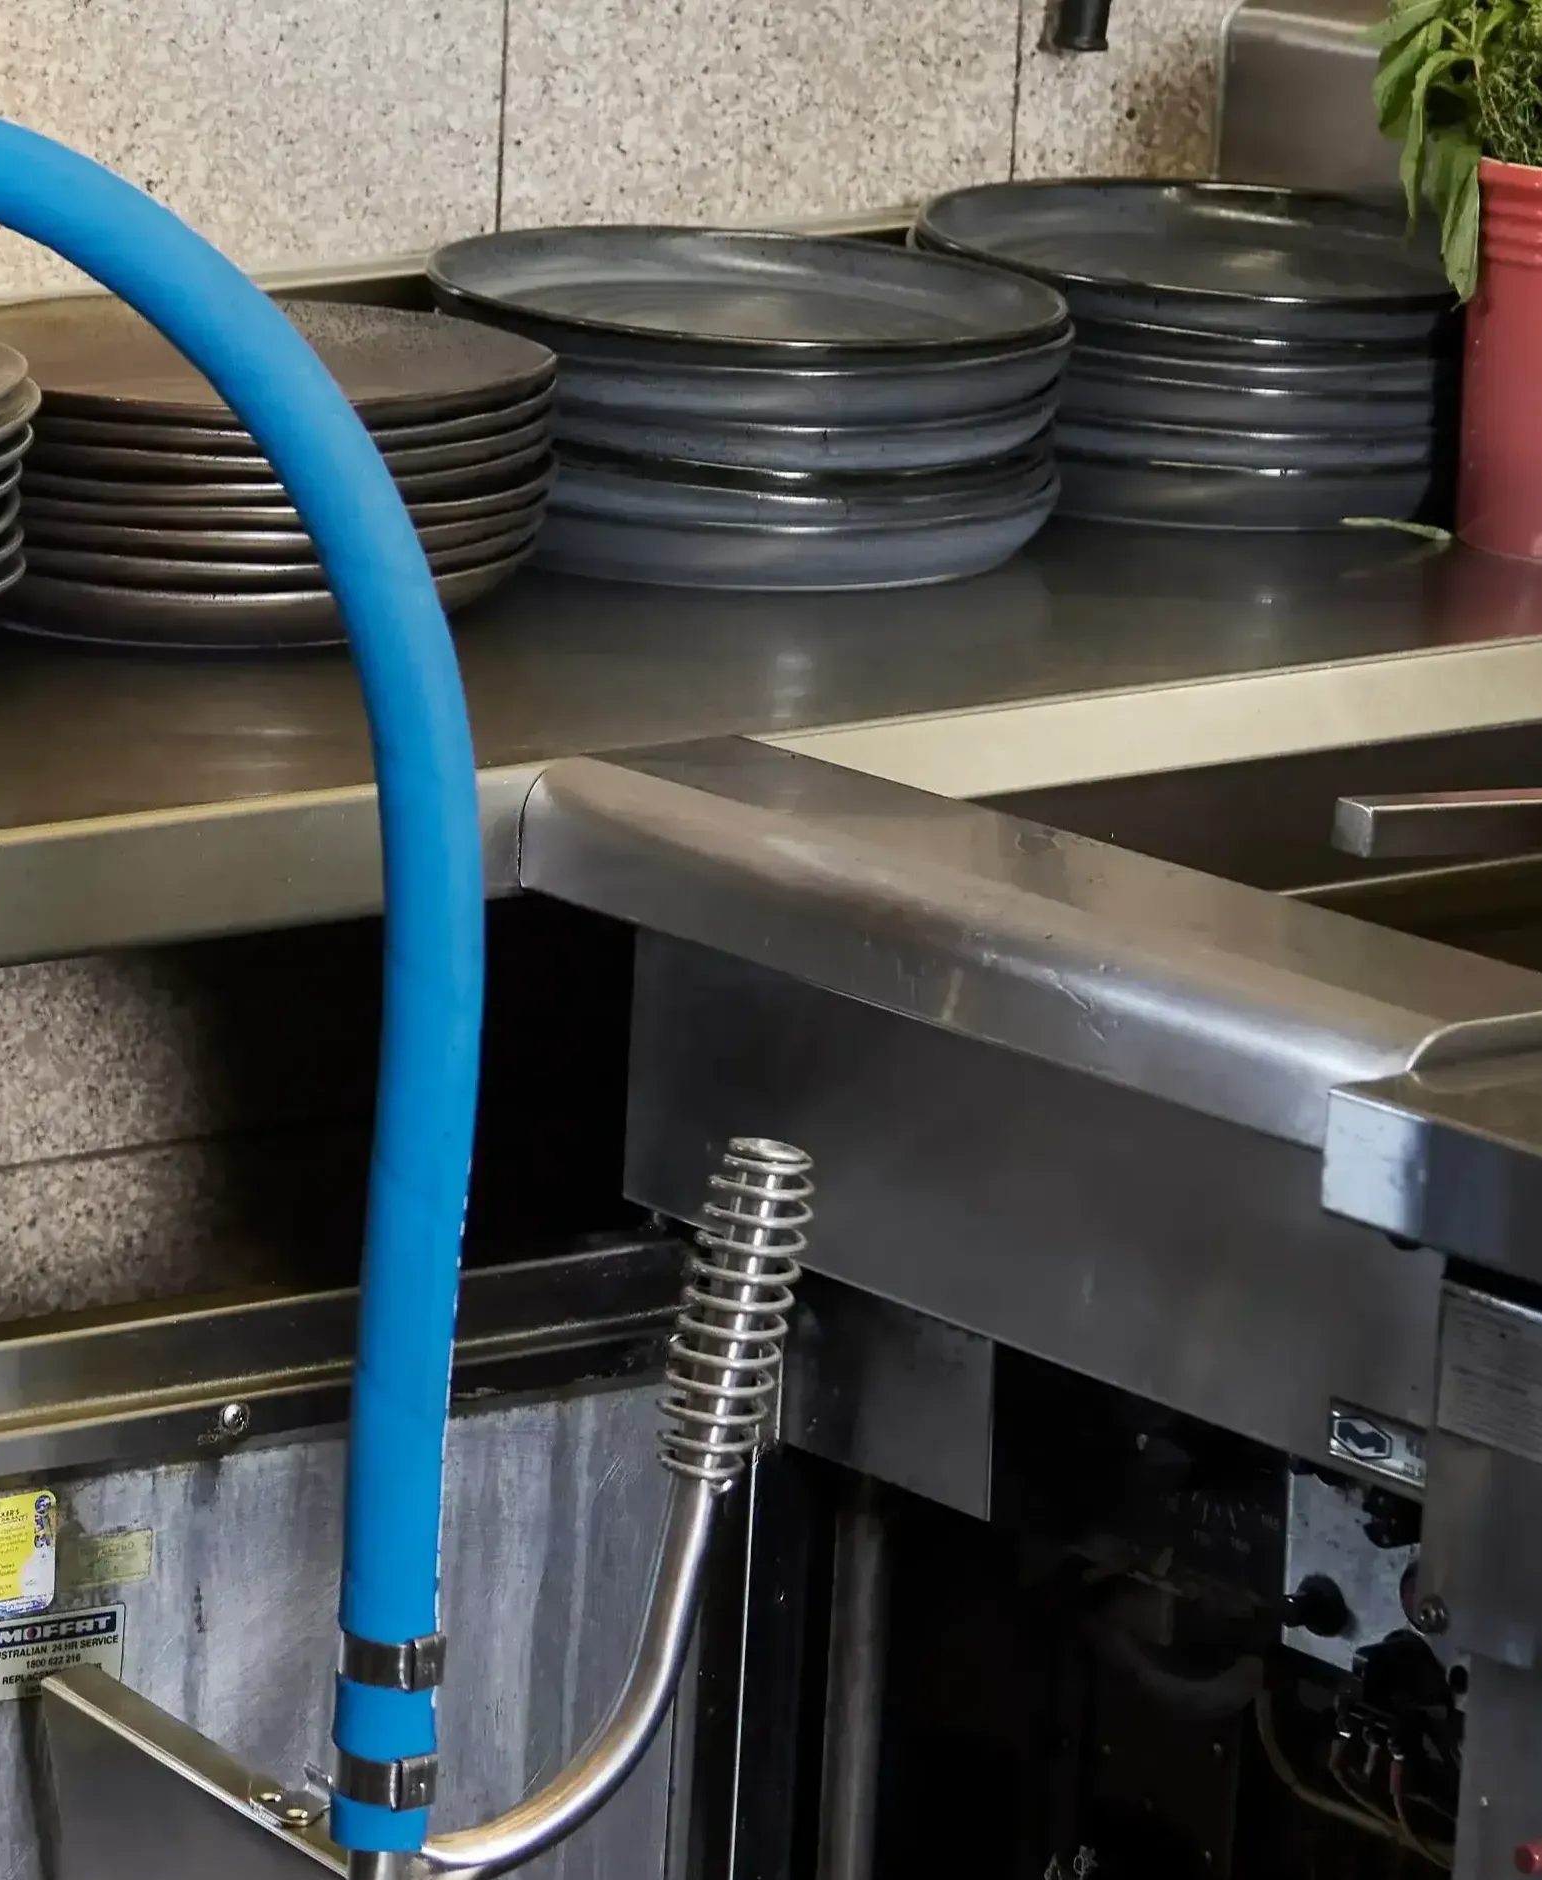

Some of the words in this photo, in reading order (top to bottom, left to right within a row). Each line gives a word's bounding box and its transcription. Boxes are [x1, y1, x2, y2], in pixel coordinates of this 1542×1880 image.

[0, 1616, 111, 1644] MOFFAT
[52, 1643, 62, 1653] 24
[64, 1641, 78, 1650] HR
[80, 1635, 118, 1649] SERVICE
[26, 1659, 45, 1669] 1800
